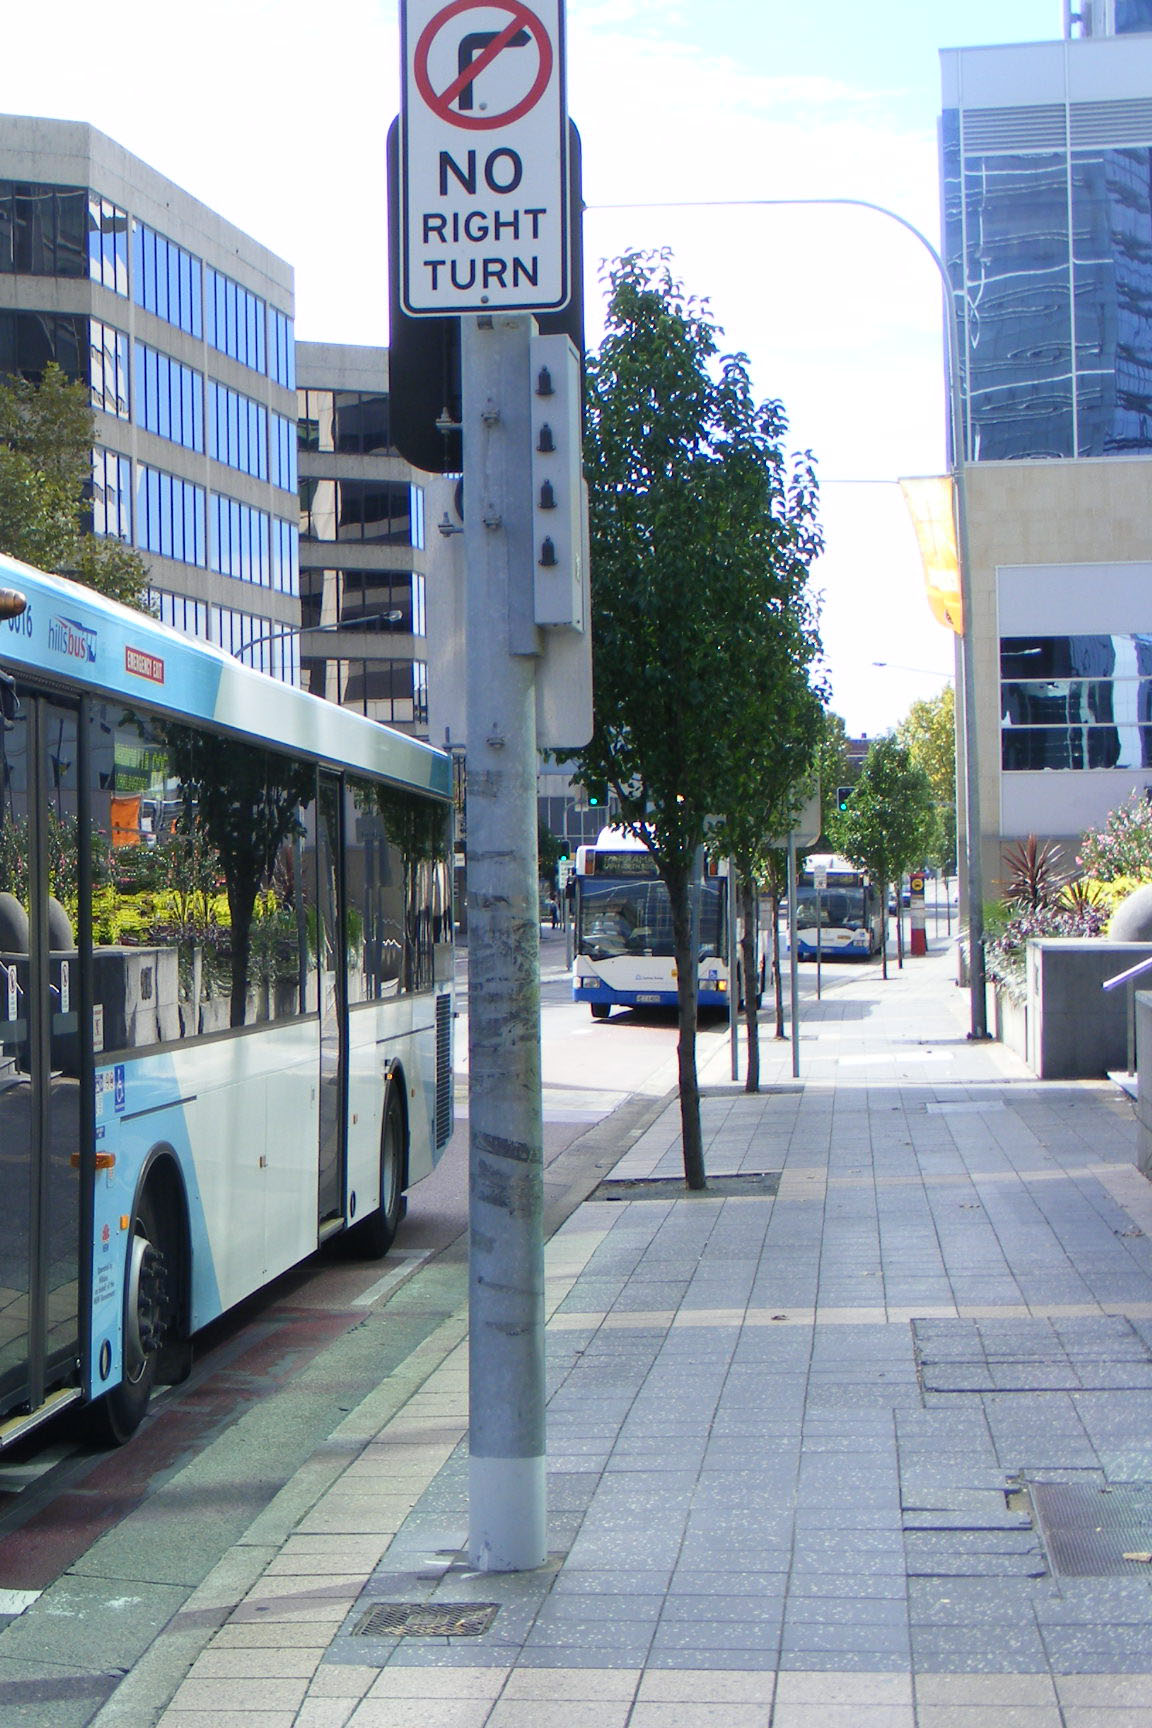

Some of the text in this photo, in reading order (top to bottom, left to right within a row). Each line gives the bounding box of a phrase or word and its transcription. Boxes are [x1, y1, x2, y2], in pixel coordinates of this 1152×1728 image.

[439, 147, 523, 197] NO
[422, 208, 547, 244] RIGHT
[424, 255, 538, 291] TURN
[48, 619, 86, 658] hillsbus
